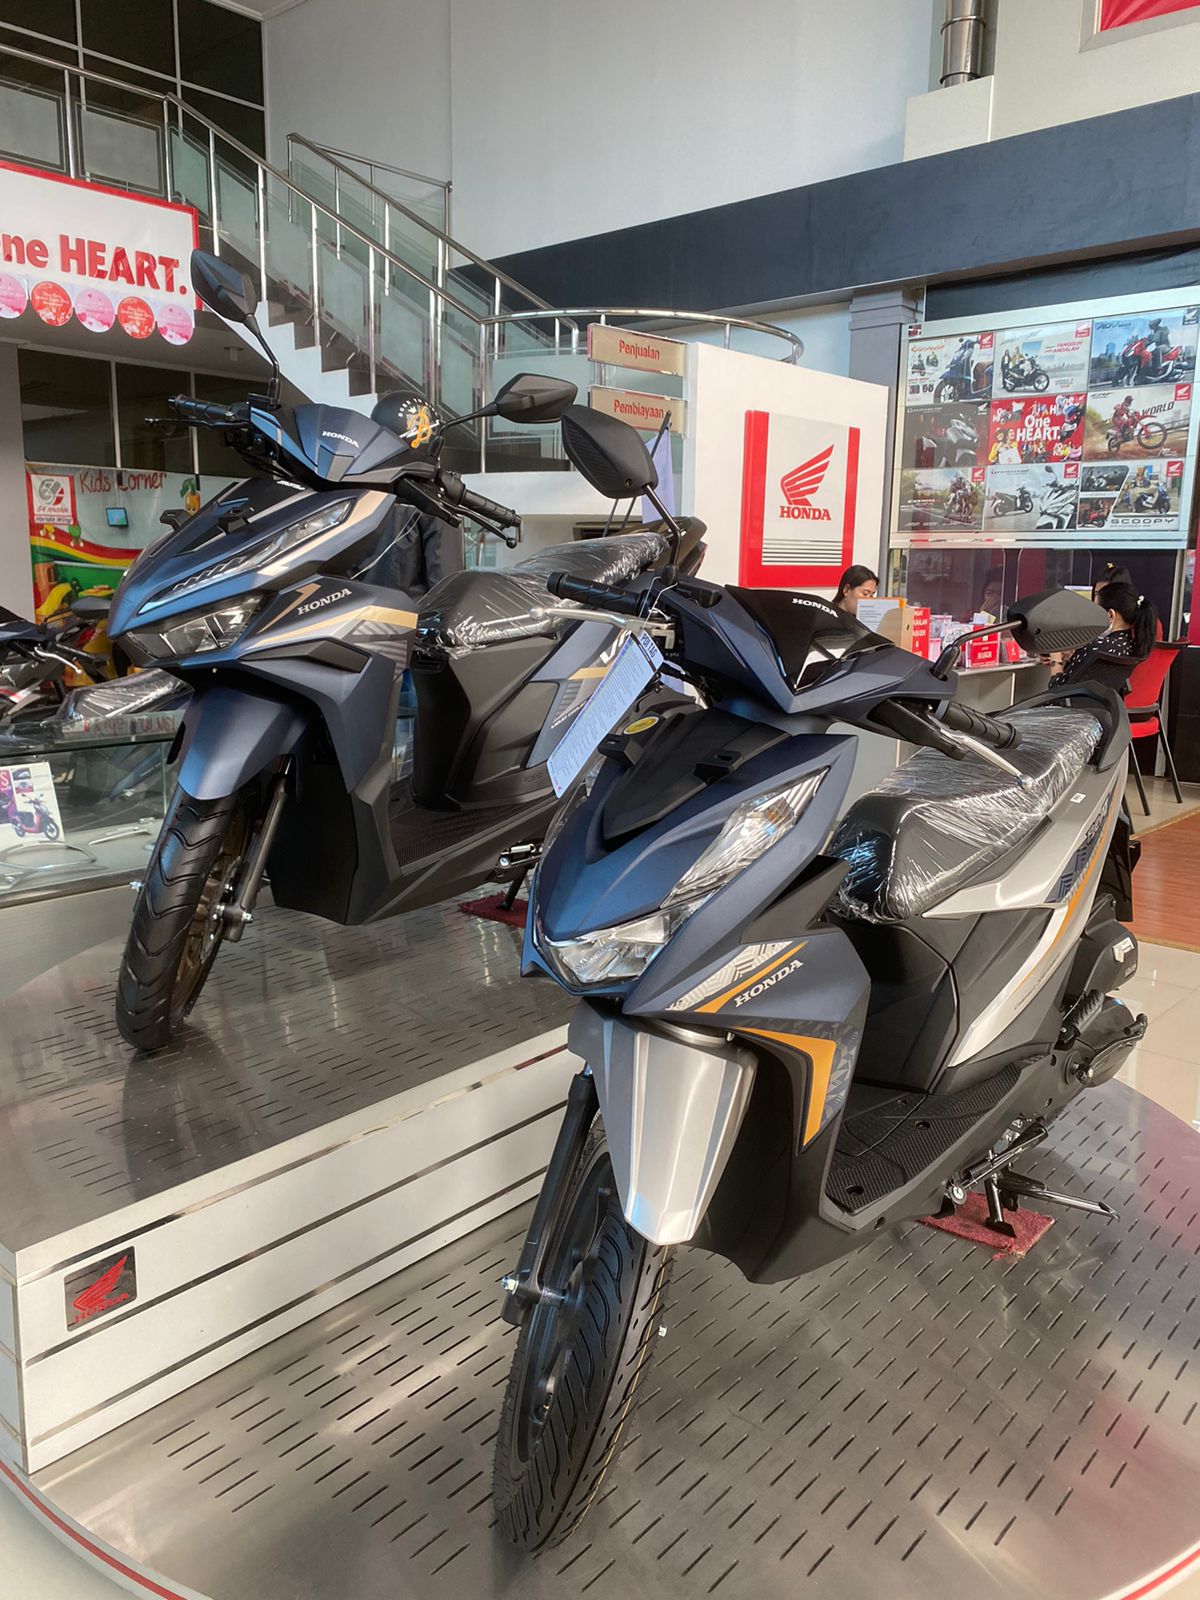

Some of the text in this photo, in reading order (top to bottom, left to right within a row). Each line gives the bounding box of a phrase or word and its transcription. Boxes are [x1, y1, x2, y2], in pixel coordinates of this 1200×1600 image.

[0, 233, 187, 296] ne HEART.
[619, 340, 660, 360] Penjualan
[614, 400, 664, 419] Pembiayaan
[1141, 401, 1175, 416] WORLD
[1024, 414, 1051, 428] One
[321, 430, 359, 448] HONDA
[1016, 426, 1061, 442] HEART.
[80, 470, 112, 493] Kids
[779, 505, 832, 521] HONDA
[297, 588, 352, 615] HONDA
[792, 598, 838, 618] HONDA
[734, 960, 803, 1007] HONDA
[73, 1293, 129, 1323] HONDA
